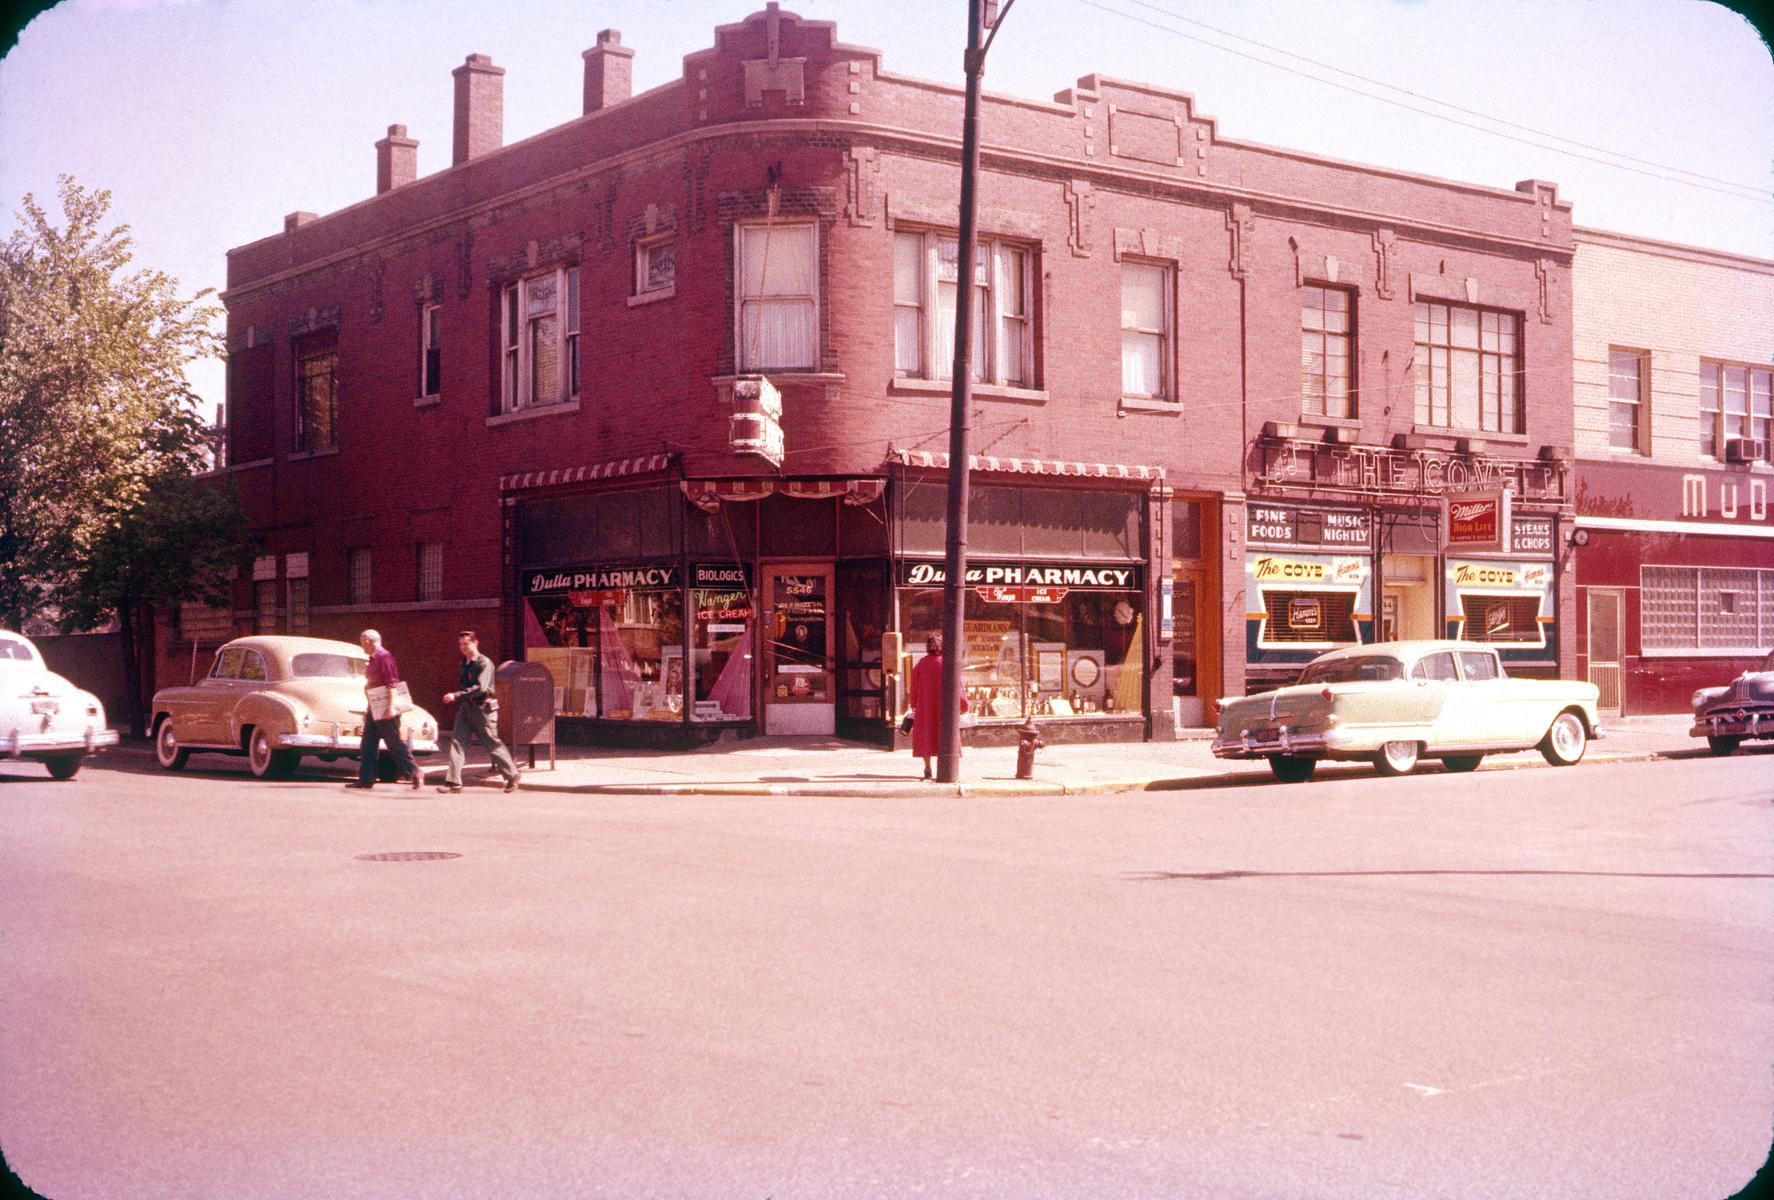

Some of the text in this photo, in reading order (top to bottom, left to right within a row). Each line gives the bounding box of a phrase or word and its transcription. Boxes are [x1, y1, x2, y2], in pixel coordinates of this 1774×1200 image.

[1331, 449, 1517, 497] THE COVE
[1256, 509, 1288, 523] FINE
[1327, 514, 1366, 528] MUSIC
[1251, 525, 1292, 539] FOODS
[1324, 529, 1369, 542] NIGHTLY
[1514, 524, 1550, 535] STEAKS
[1514, 538, 1550, 549] & CHOPS
[698, 569, 744, 581] BIOLOGICS
[908, 564, 1130, 586] Dua PHARMACY
[1256, 558, 1323, 578] The COVE
[1456, 565, 1513, 584] The COVE
[530, 569, 673, 592] Dulla PHARMACY
[697, 608, 752, 620] ICE CREAM
